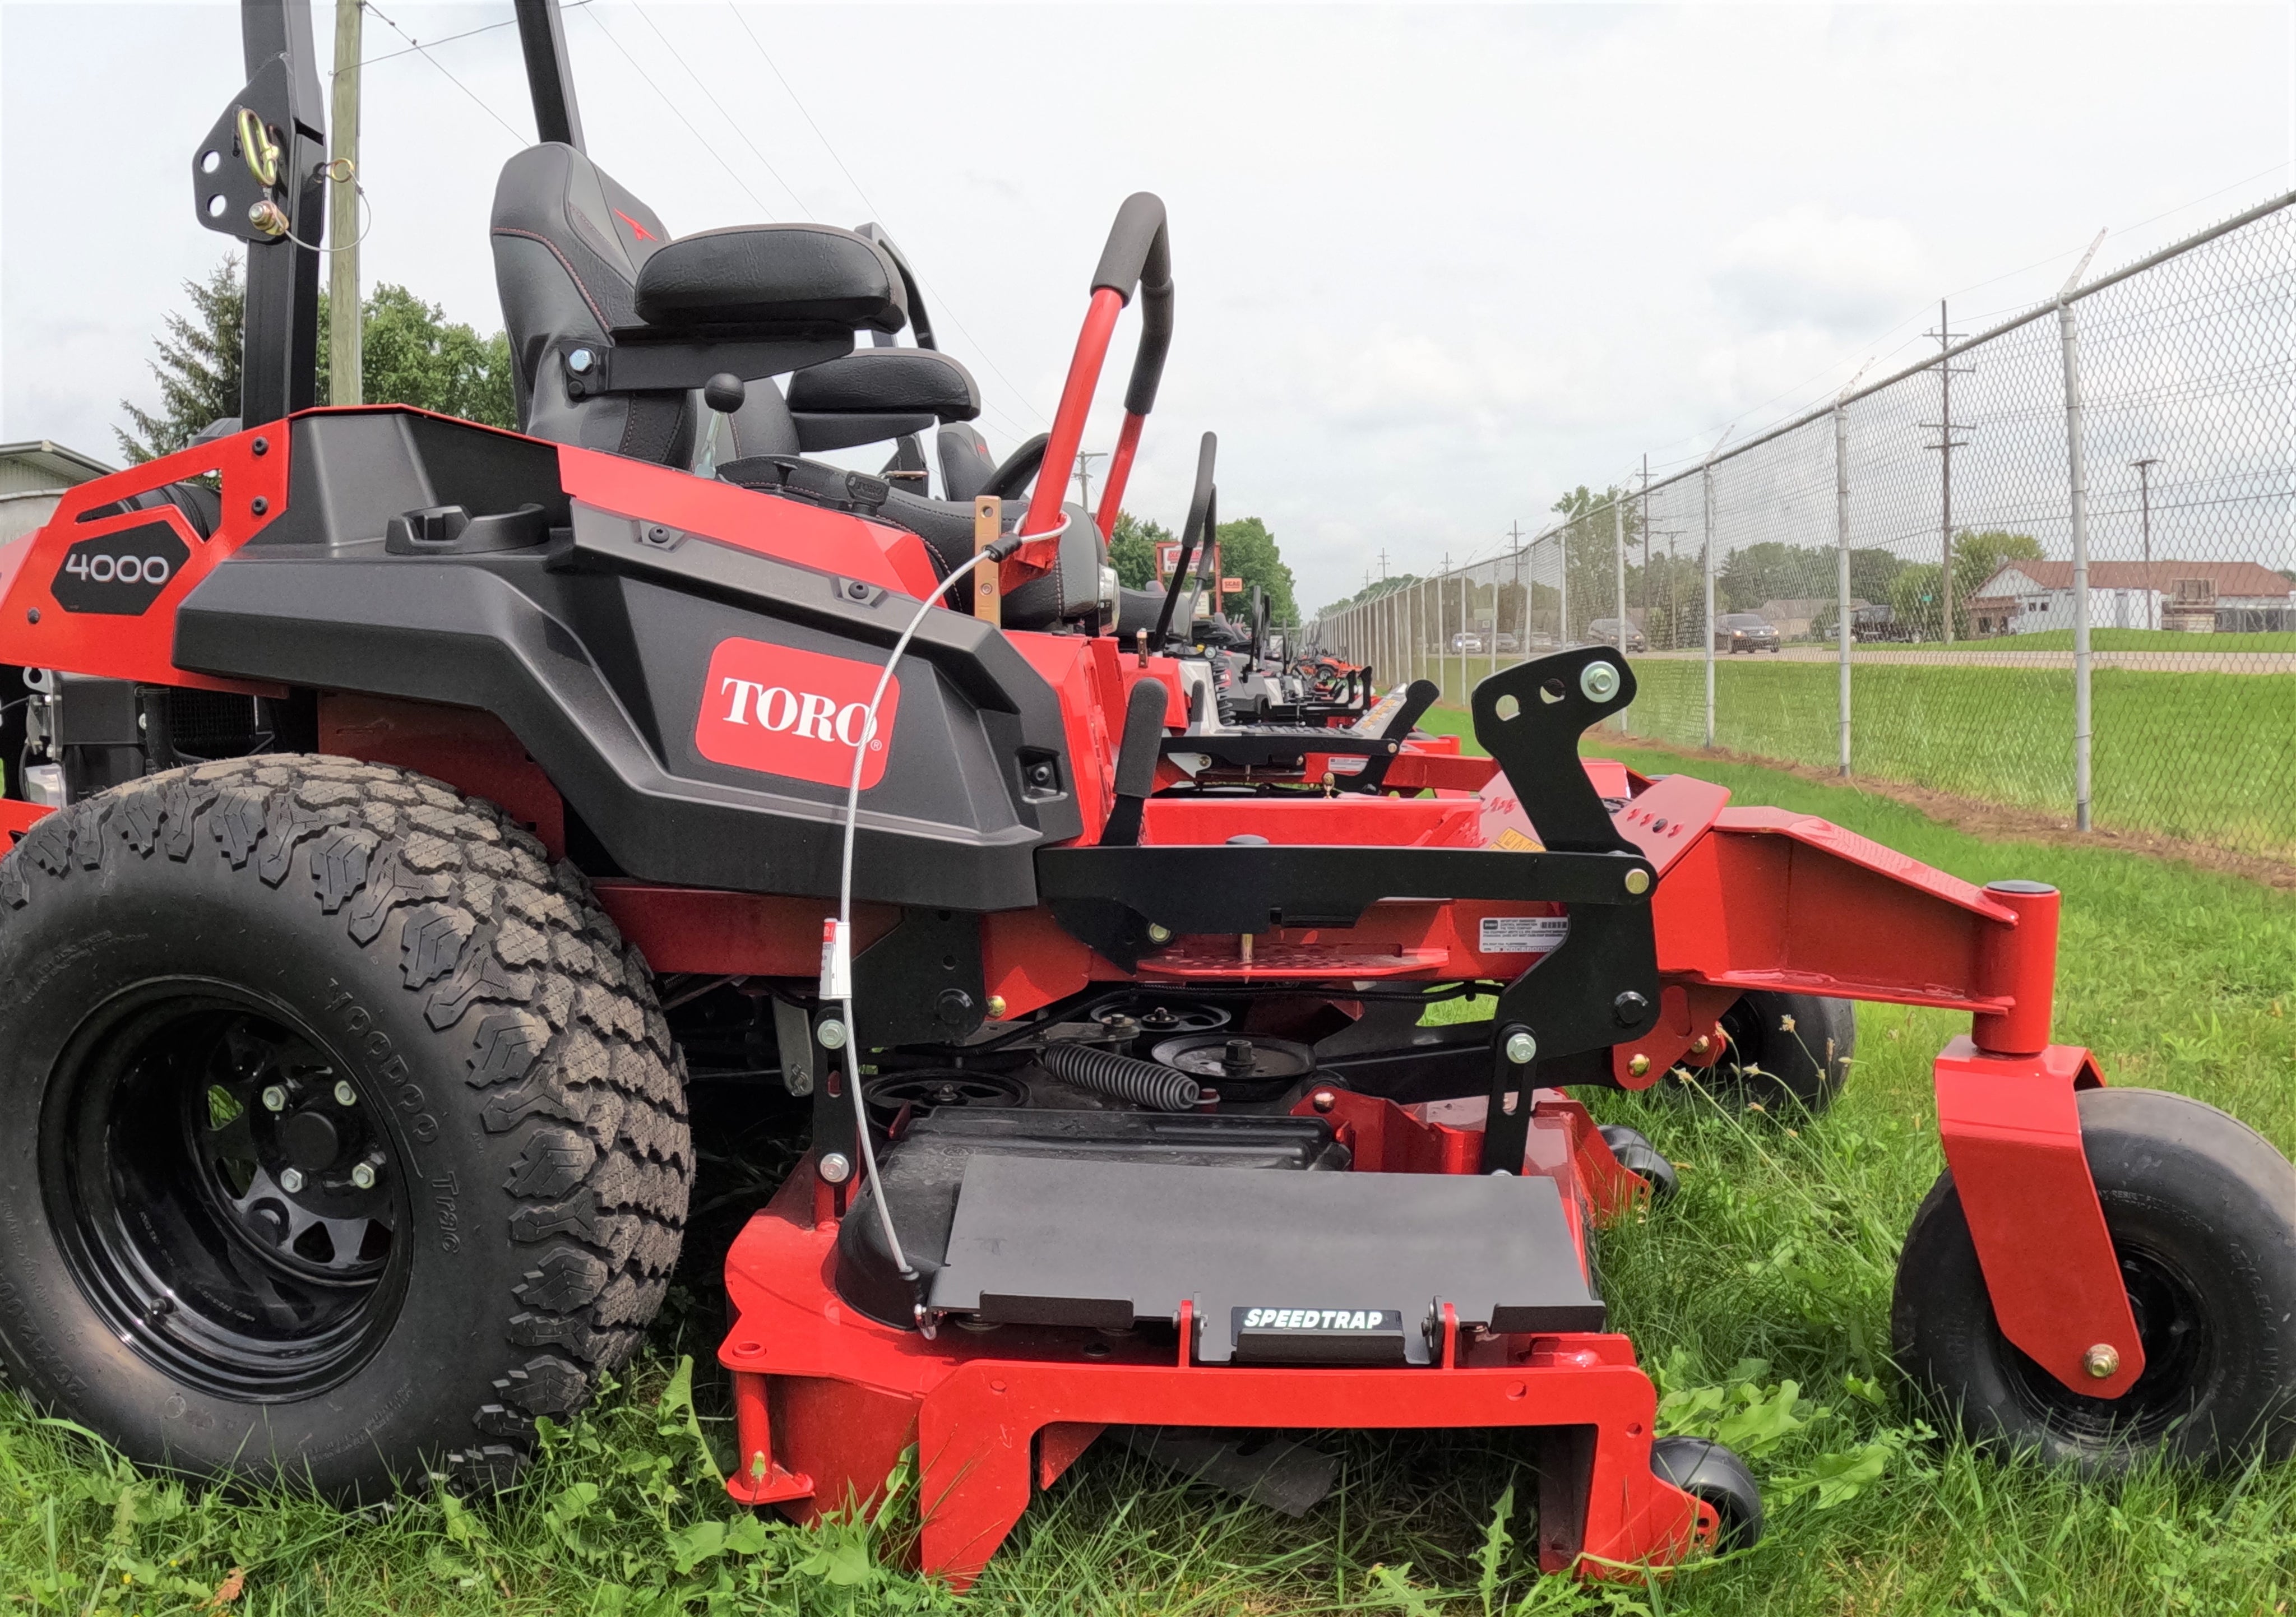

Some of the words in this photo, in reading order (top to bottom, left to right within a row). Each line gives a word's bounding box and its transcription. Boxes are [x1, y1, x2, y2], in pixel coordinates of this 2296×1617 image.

[66, 554, 169, 584] 4000
[721, 677, 878, 748] TORO
[324, 976, 439, 1145] VOODOO
[431, 1171, 461, 1254] Trac
[1244, 1309, 1383, 1329] SPEEDTRAP
